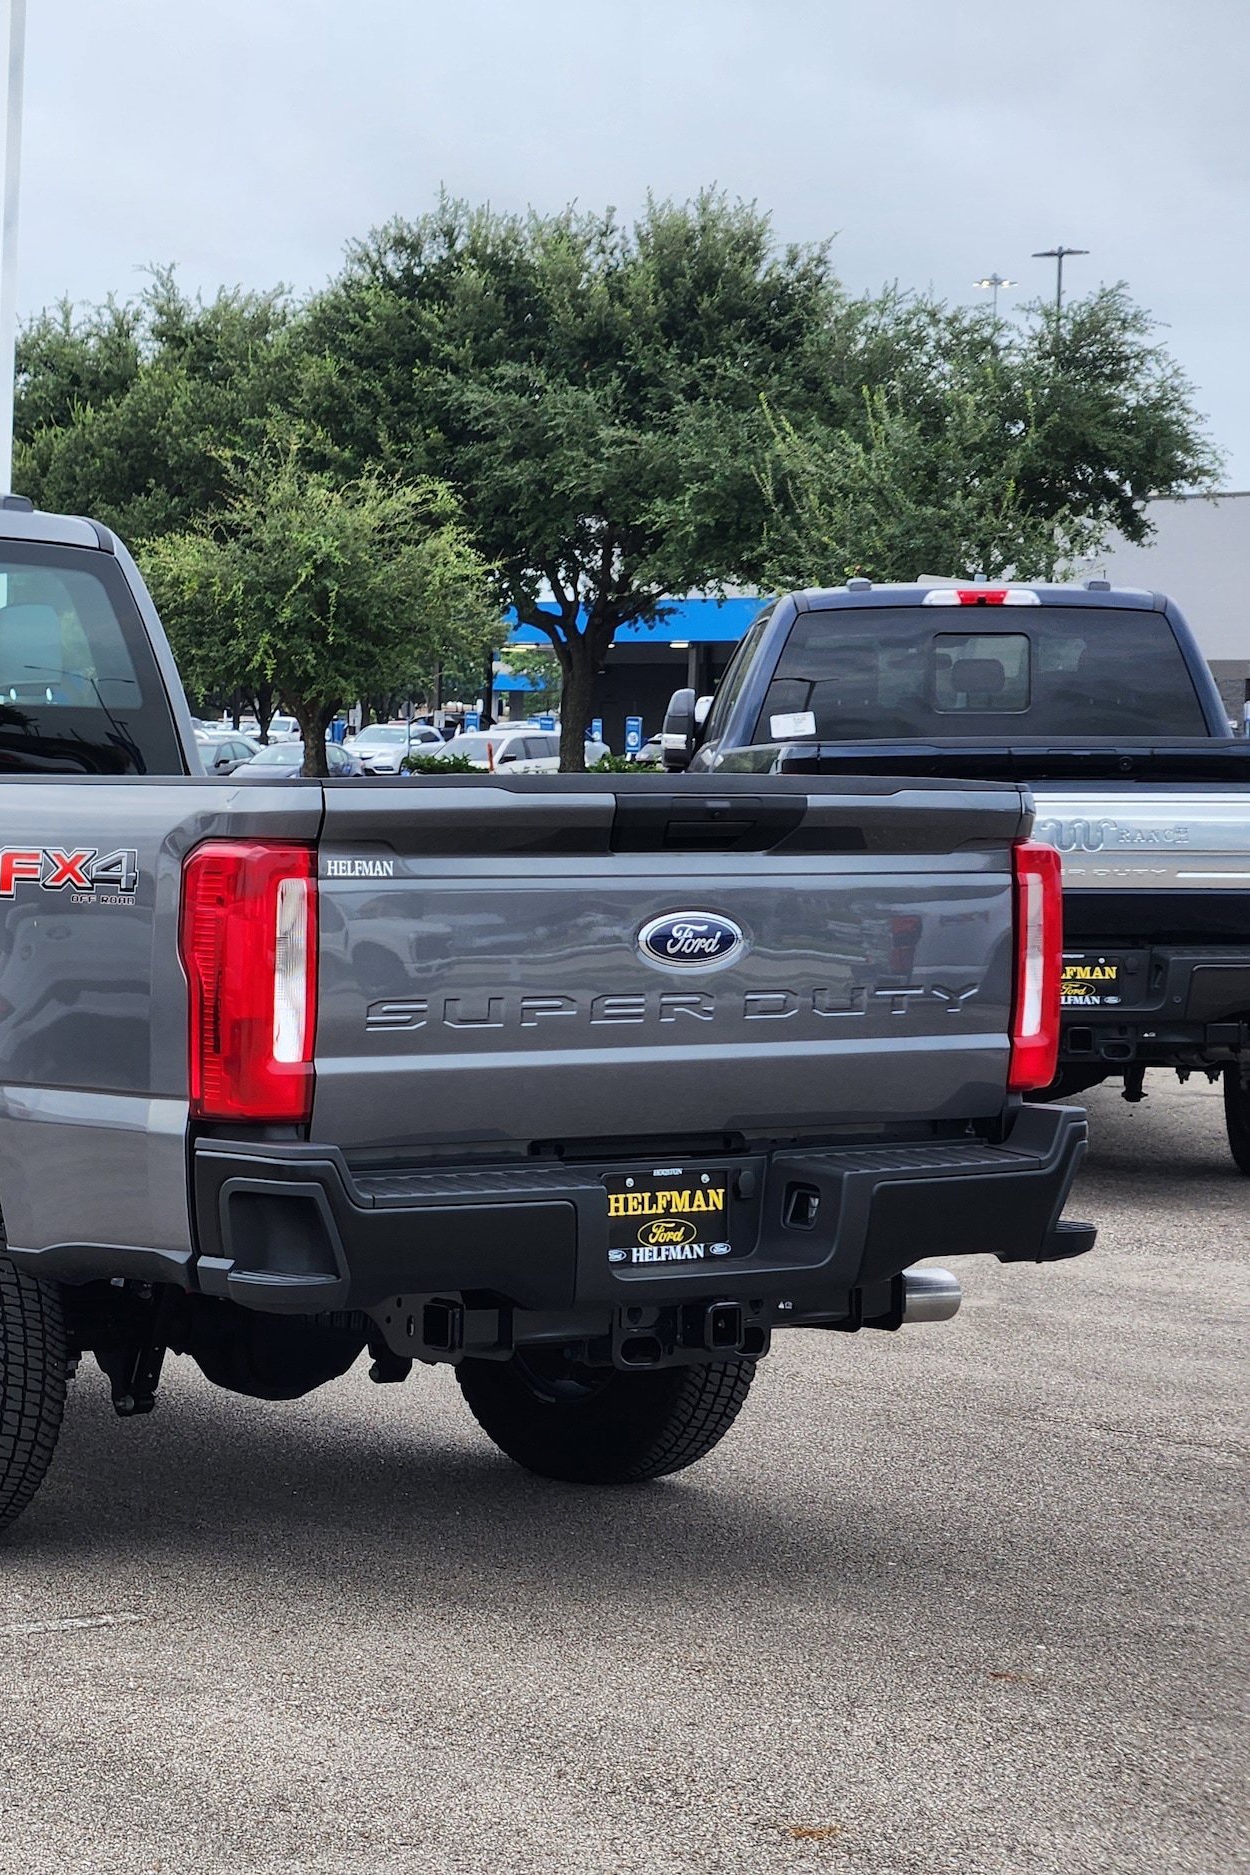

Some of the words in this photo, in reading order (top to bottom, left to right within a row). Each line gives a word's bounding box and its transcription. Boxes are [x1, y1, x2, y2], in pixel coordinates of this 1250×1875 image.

[1118, 828, 1190, 844] RANCH
[326, 860, 394, 876] HELFMAN
[70, 894, 97, 905] OFF
[100, 894, 136, 906] ROAD
[666, 923, 722, 955] Ford
[365, 991, 715, 1032] SUPER
[744, 983, 979, 1020] DUTY
[1060, 996, 1101, 1005] LFMAN
[608, 1189, 725, 1216] HELFMAN
[648, 1222, 686, 1244] Ford
[631, 1244, 705, 1262] HELFMAN
